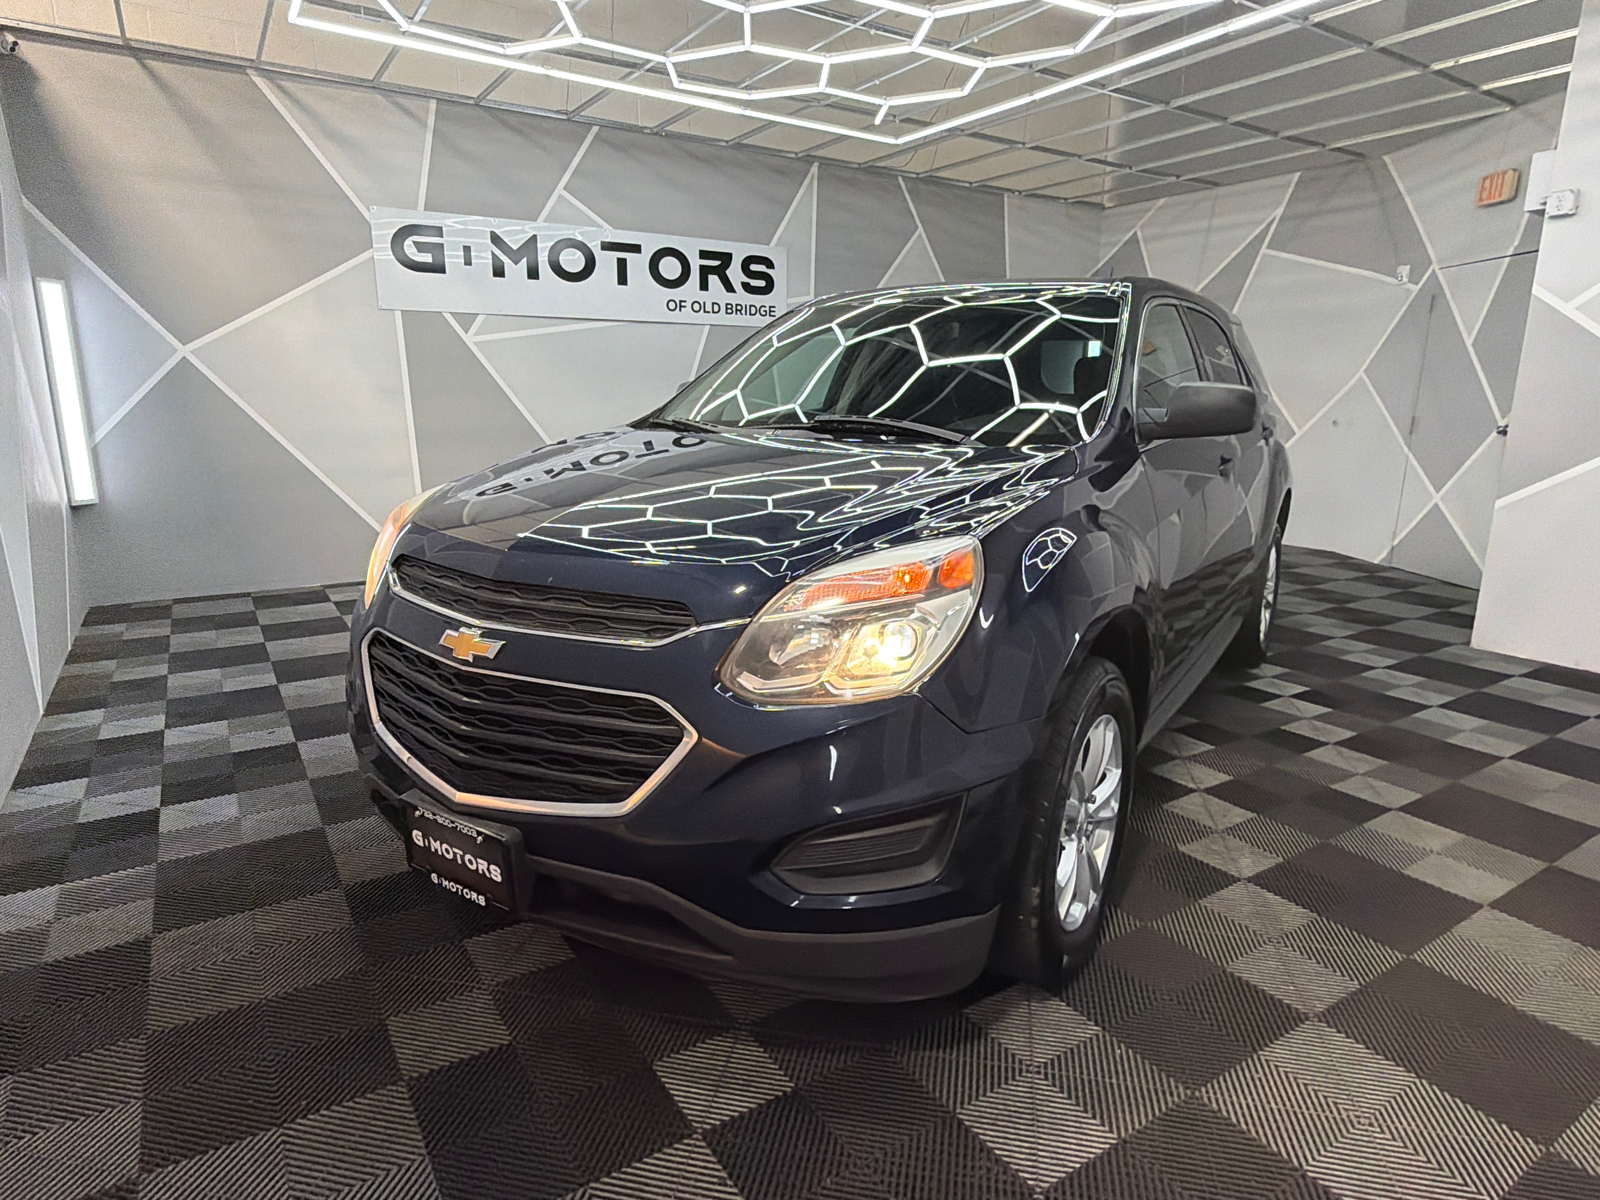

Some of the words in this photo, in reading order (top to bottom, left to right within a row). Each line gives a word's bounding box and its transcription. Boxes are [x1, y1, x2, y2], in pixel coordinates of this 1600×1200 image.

[666, 299, 687, 312] OF
[691, 301, 721, 314] OLD
[725, 303, 777, 318] BRIDGE
